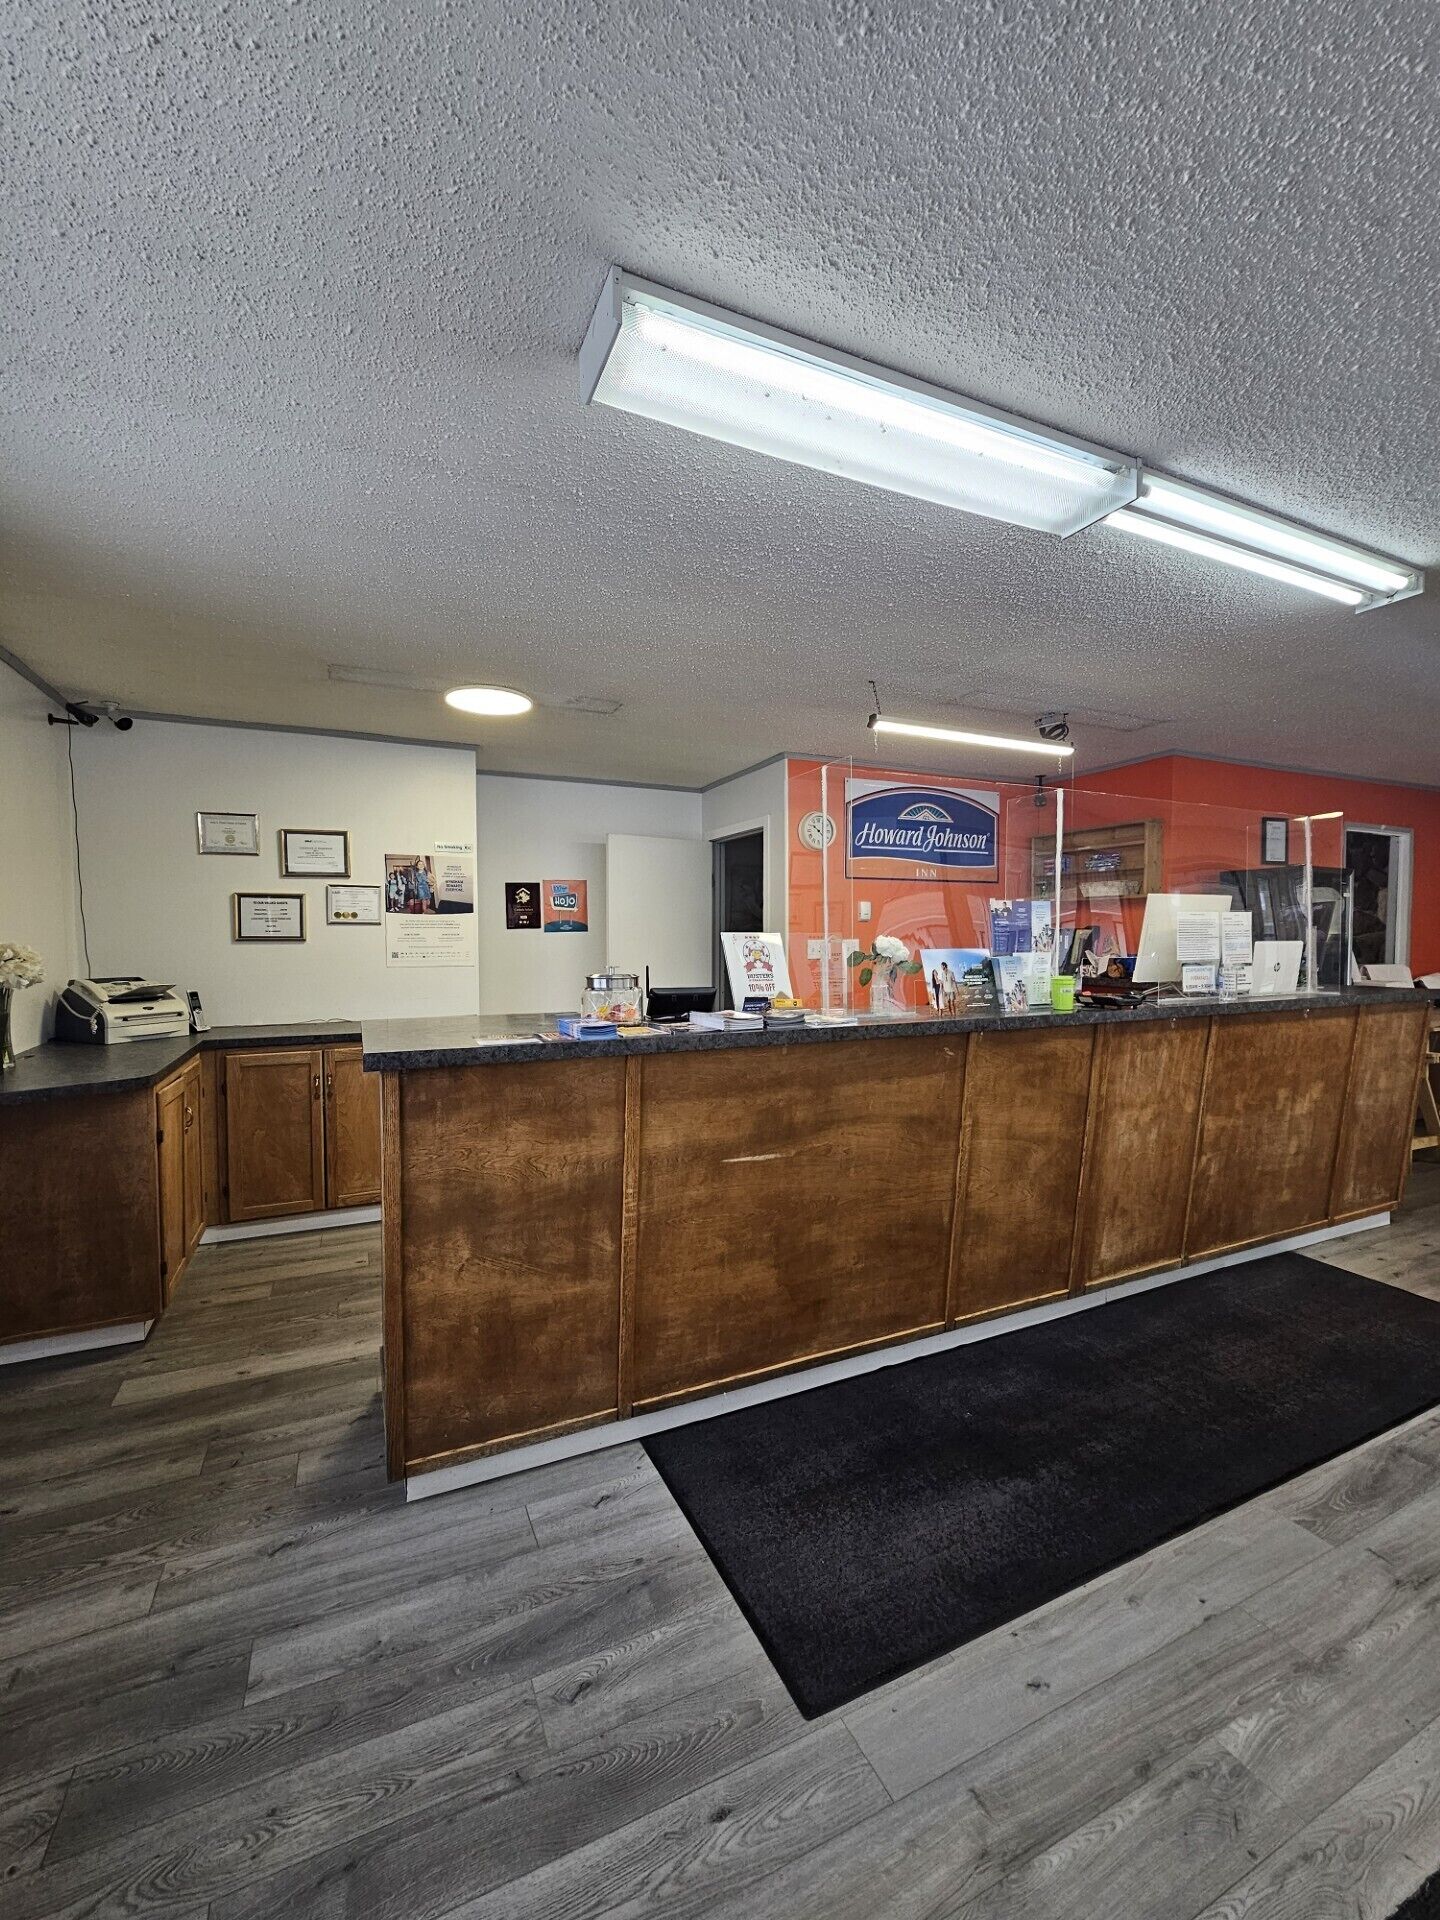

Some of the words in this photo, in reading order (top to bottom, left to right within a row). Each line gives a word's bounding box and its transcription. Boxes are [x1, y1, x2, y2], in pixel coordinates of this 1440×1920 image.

[855, 822, 924, 846] Howard
[922, 825, 987, 852] Johnson
[915, 868, 937, 877] INN
[765, 983, 776, 992] OFF
